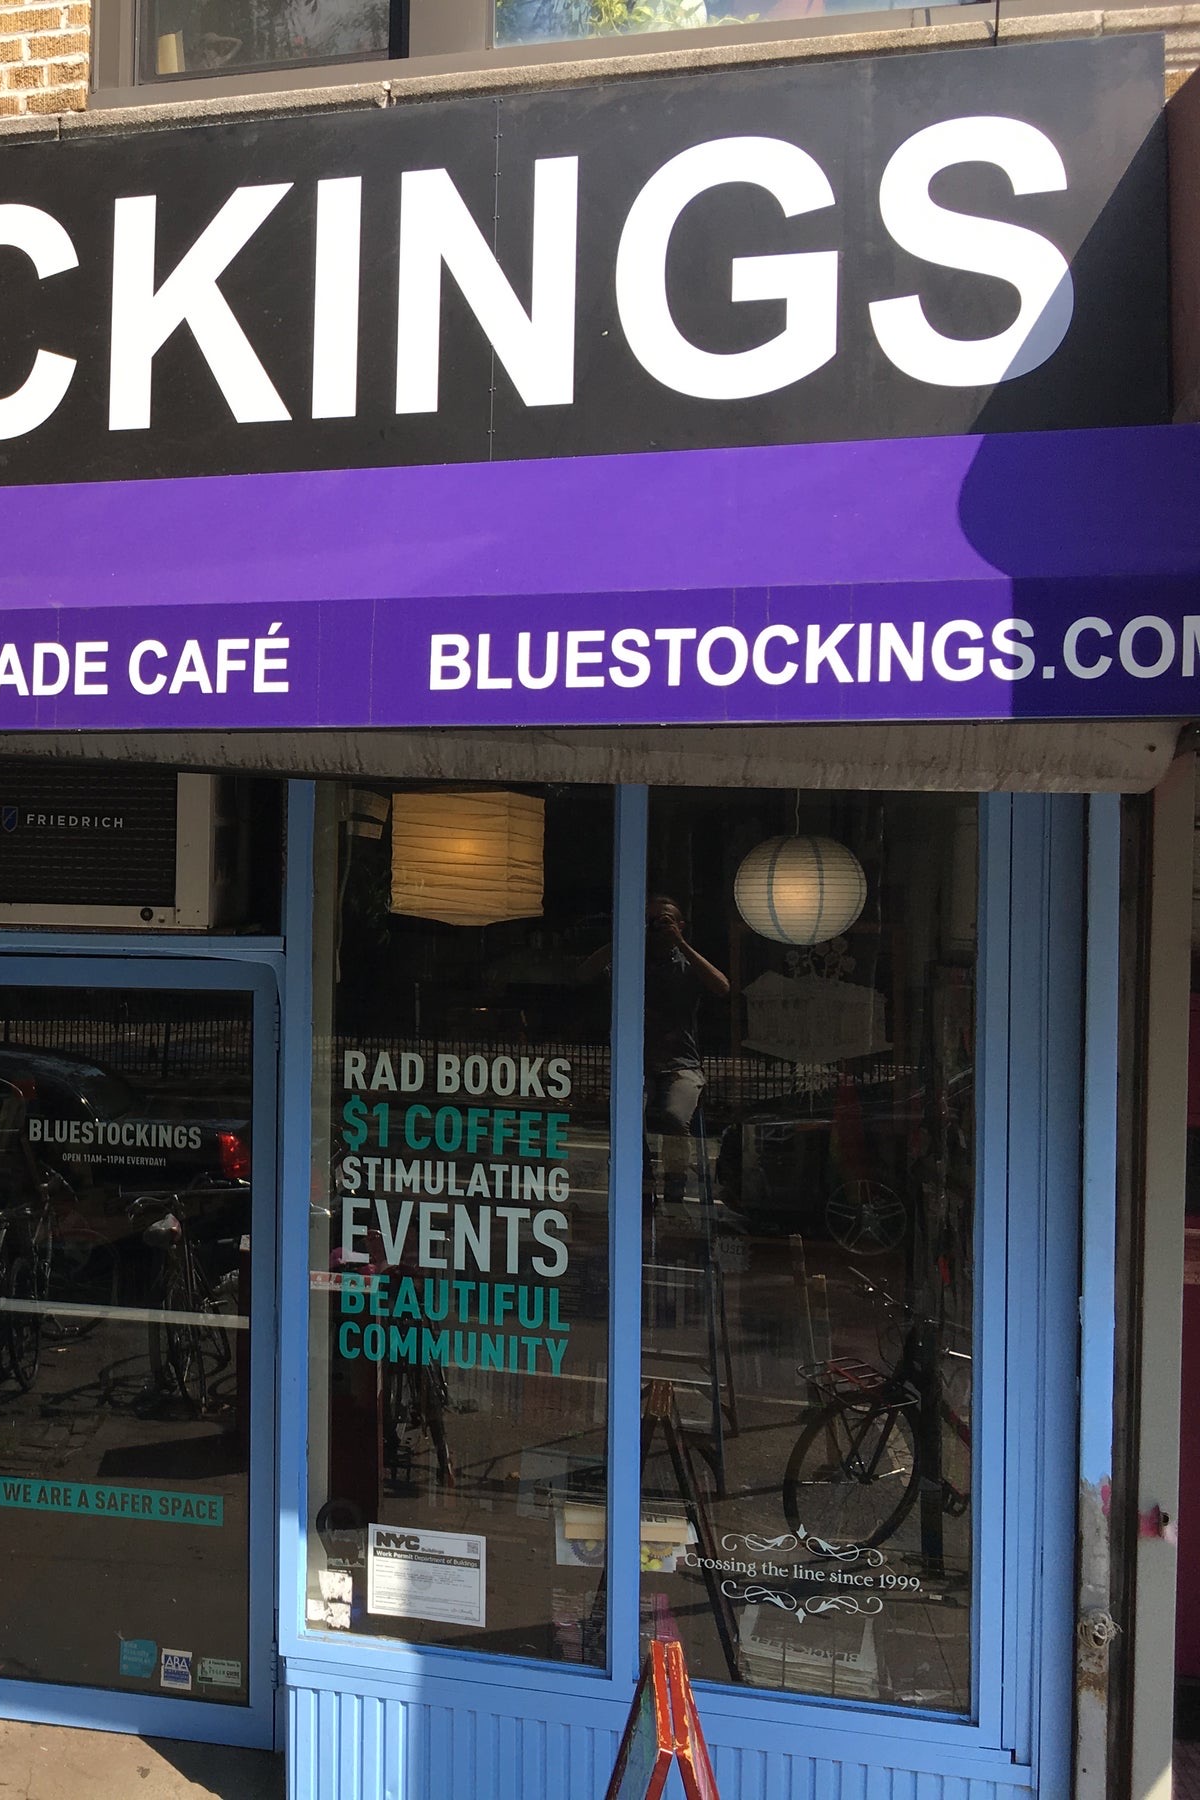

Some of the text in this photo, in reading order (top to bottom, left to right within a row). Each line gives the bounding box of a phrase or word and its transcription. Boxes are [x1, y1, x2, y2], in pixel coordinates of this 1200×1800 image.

[128, 622, 291, 695] CAFÉ
[26, 813, 124, 829] FRIEDRICH
[343, 1050, 572, 1099] RAD BOOKS
[29, 1118, 201, 1150] BLUESTOCKINGS
[342, 1095, 570, 1159] $1 COFFEE
[62, 1152, 81, 1162] OPEN
[341, 1156, 570, 1203] STIMULATING
[341, 1196, 569, 1278] EVENTS
[340, 1272, 570, 1332] BEAUTIFUL
[339, 1321, 569, 1377] COMMUNITY
[3, 1481, 218, 1521] WE ARE A SAFER SPACE
[375, 1550, 393, 1558] Work
[393, 1552, 414, 1560] Permit
[414, 1553, 446, 1564] Department
[453, 1559, 478, 1568] Buildings
[376, 1531, 420, 1551] NYC
[684, 1552, 924, 1593] Crossing the line since 1999.
